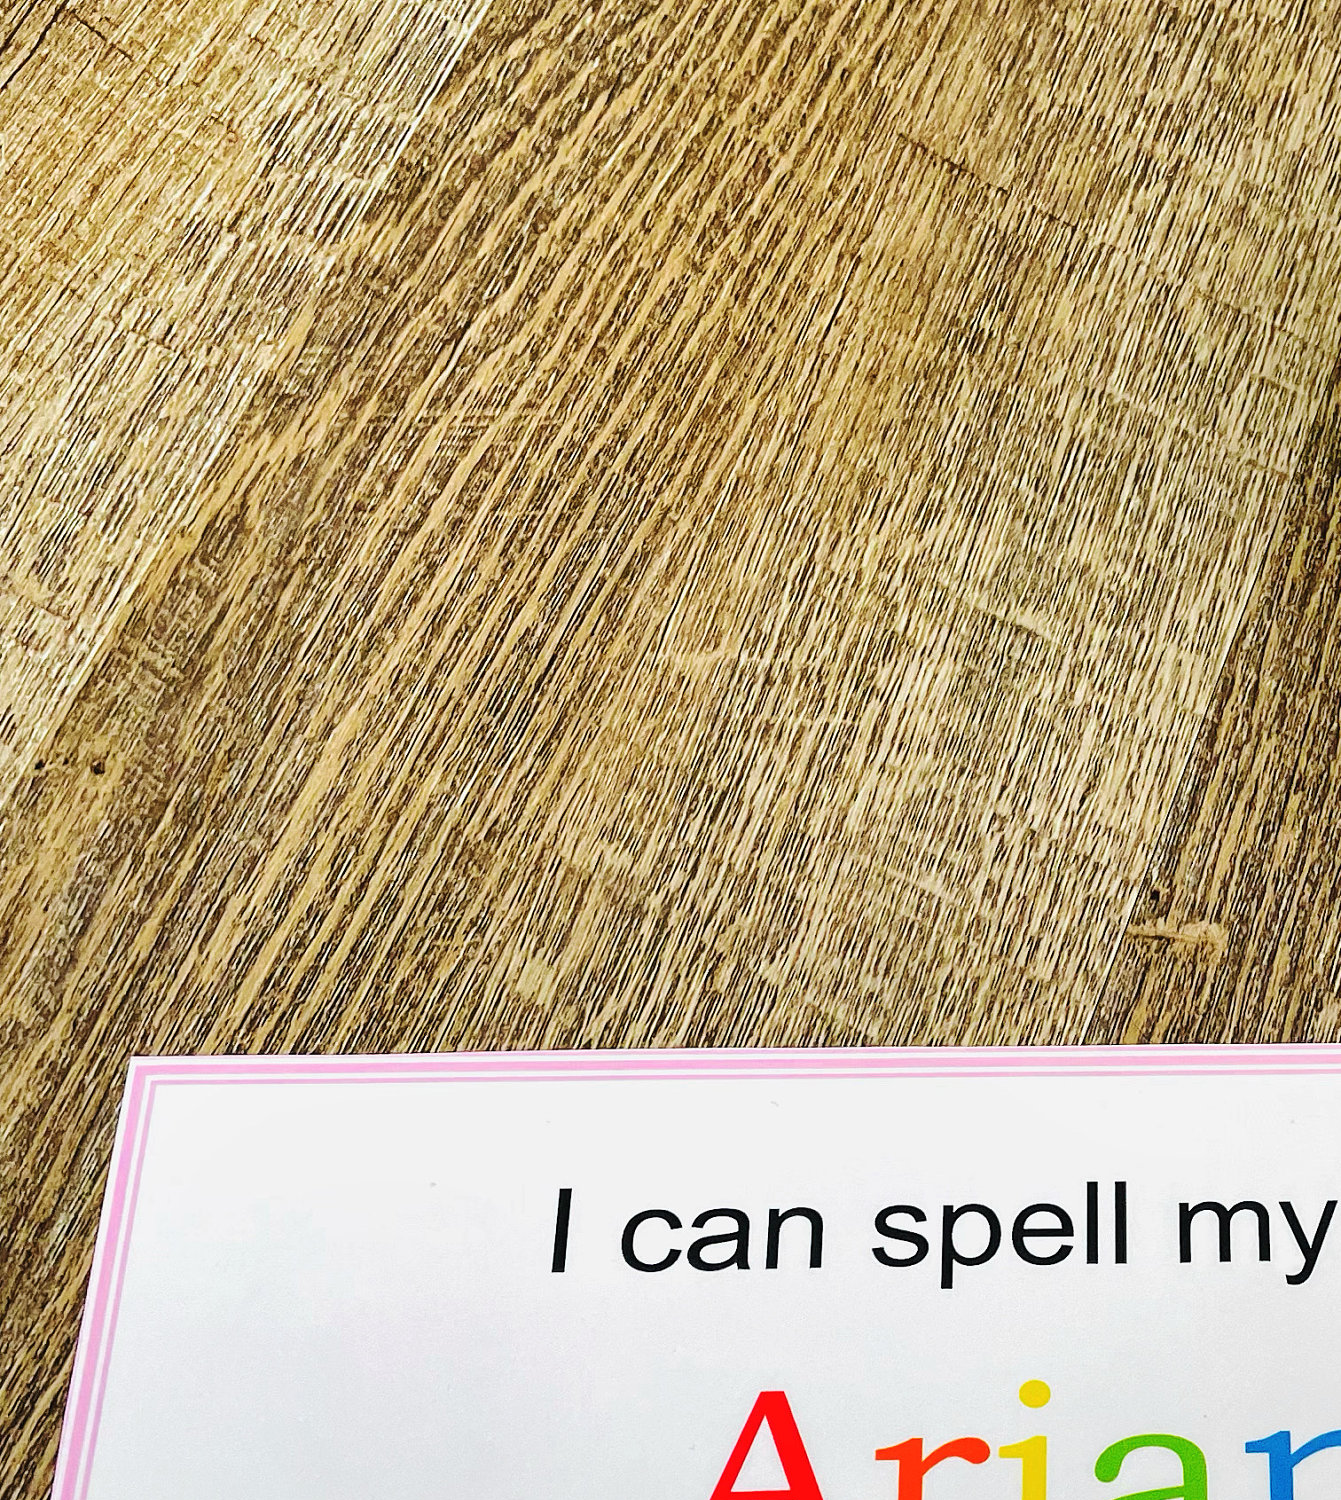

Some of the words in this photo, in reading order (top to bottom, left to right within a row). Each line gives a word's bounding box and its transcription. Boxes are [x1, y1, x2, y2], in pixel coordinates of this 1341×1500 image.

[551, 1188, 573, 1273] I
[621, 1206, 824, 1273] can
[871, 1181, 1128, 1290] spell
[1178, 1199, 1338, 1286] my
